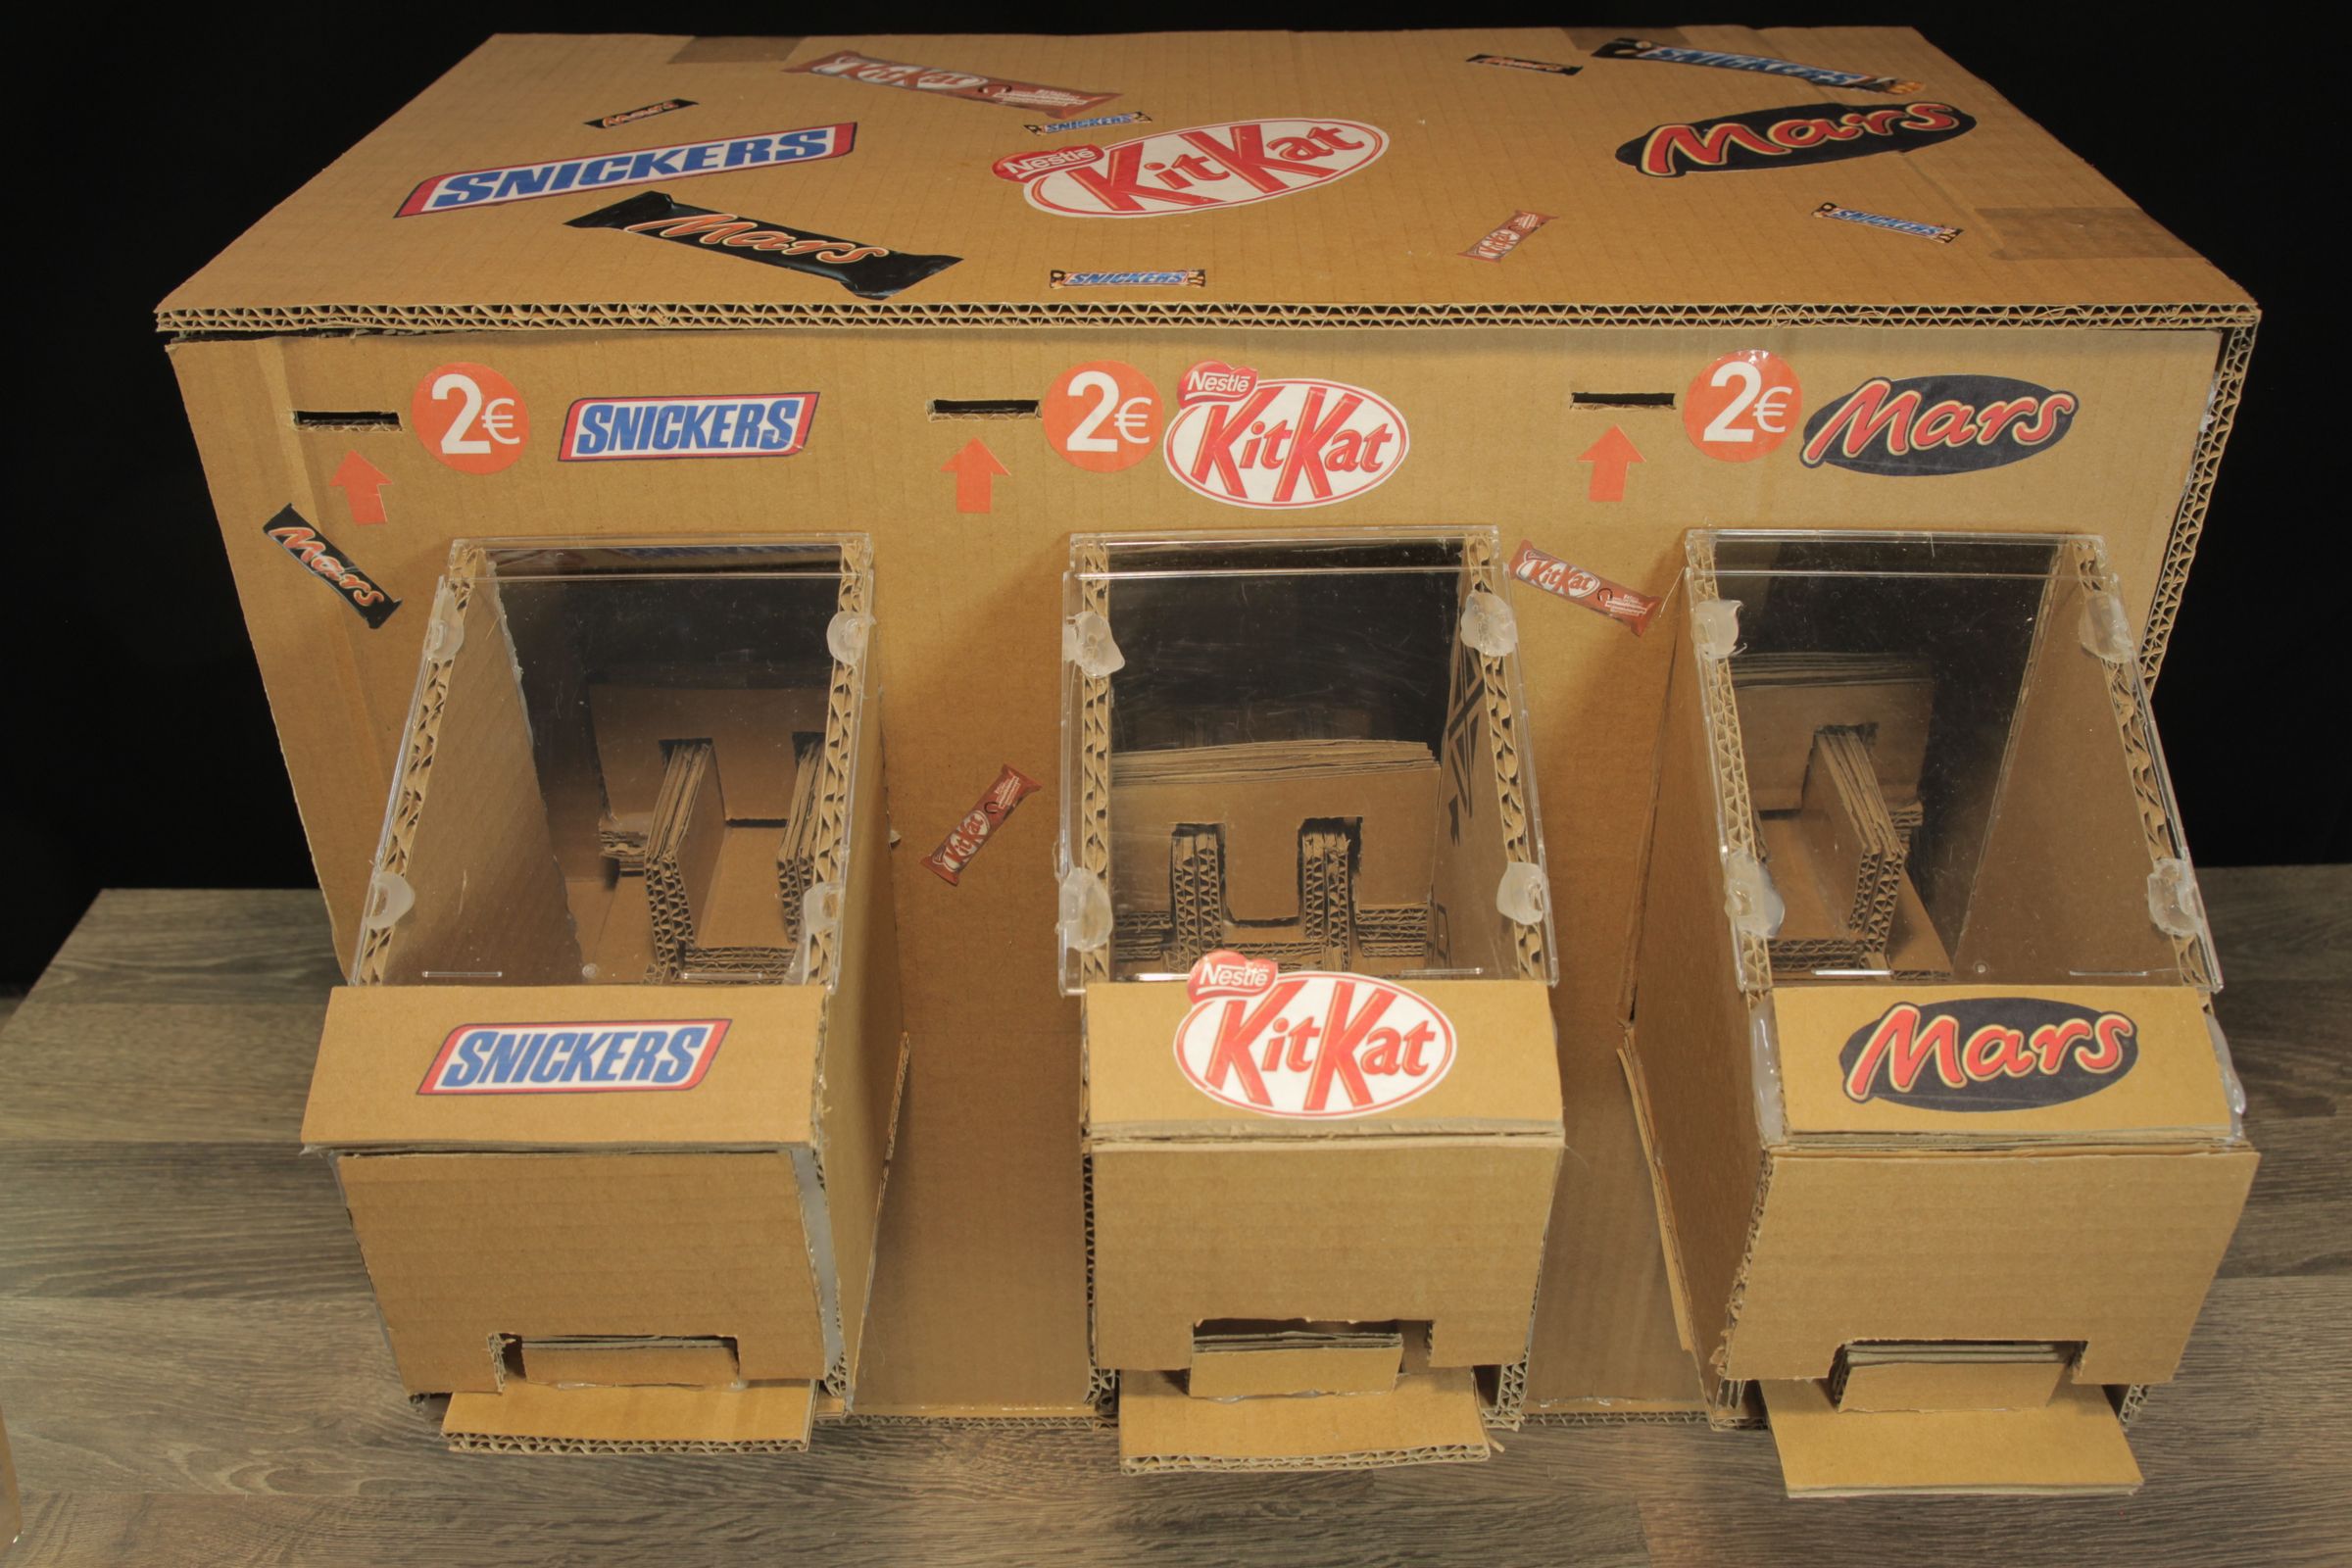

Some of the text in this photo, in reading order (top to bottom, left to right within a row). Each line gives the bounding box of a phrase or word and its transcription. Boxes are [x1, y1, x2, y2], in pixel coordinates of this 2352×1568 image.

[1046, 115, 1133, 133] SNICKERS
[1640, 102, 1961, 176] Mars
[431, 127, 830, 209] SNICKERS
[1066, 123, 1365, 212] KitKat
[624, 213, 890, 265] Mars
[1070, 271, 1186, 284] SNICKERS
[431, 372, 520, 455] 2€
[575, 399, 802, 455] SNICKERS
[1066, 370, 1152, 452] 2€
[1702, 361, 1792, 443] 2€
[1803, 377, 2076, 465] Mars
[1190, 385, 1393, 502] KitKat
[268, 525, 385, 609] Mars
[1526, 560, 1594, 597] KitKat
[441, 1027, 709, 1088] SNICKERS
[1204, 979, 1437, 1111] KitKat
[1845, 1004, 2134, 1102] Mars
